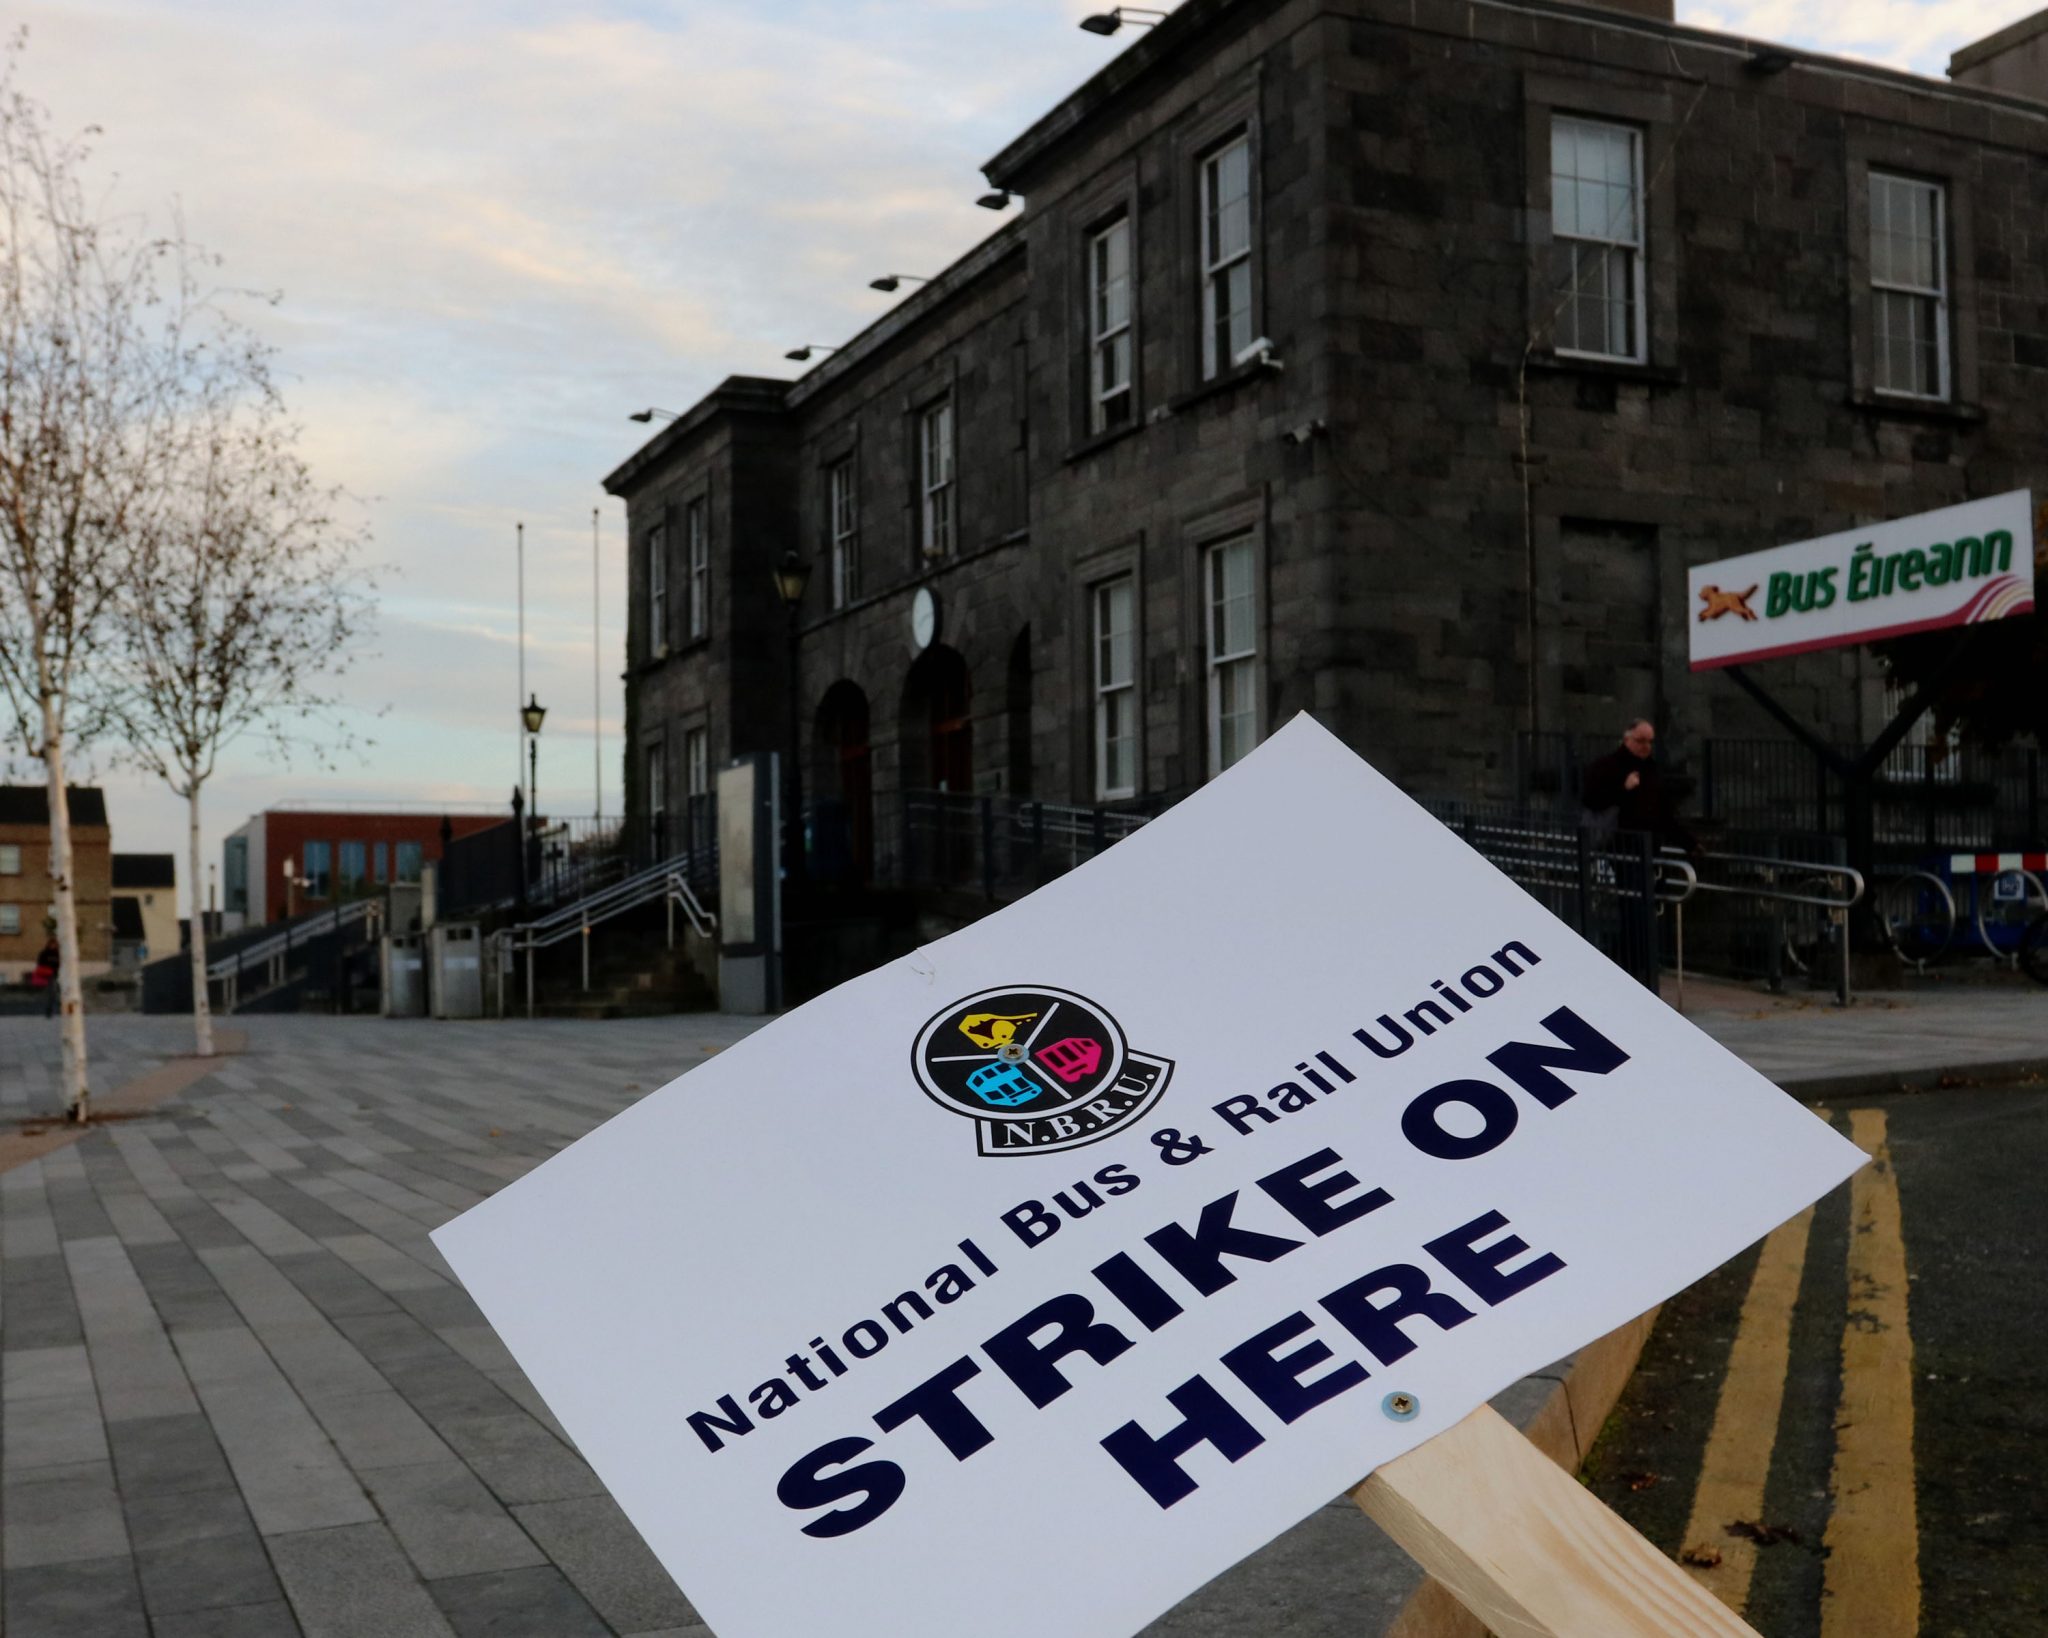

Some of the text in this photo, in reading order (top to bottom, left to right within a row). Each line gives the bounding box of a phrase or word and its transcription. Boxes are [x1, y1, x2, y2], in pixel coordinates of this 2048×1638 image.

[1765, 566, 1838, 618] Bus
[686, 941, 1541, 1453] National Bus & Rail Union
[1003, 1073, 1155, 1146] N.B.R.U.
[777, 1006, 1631, 1538] STRIKE ON
[1100, 1209, 1567, 1510] HERE
